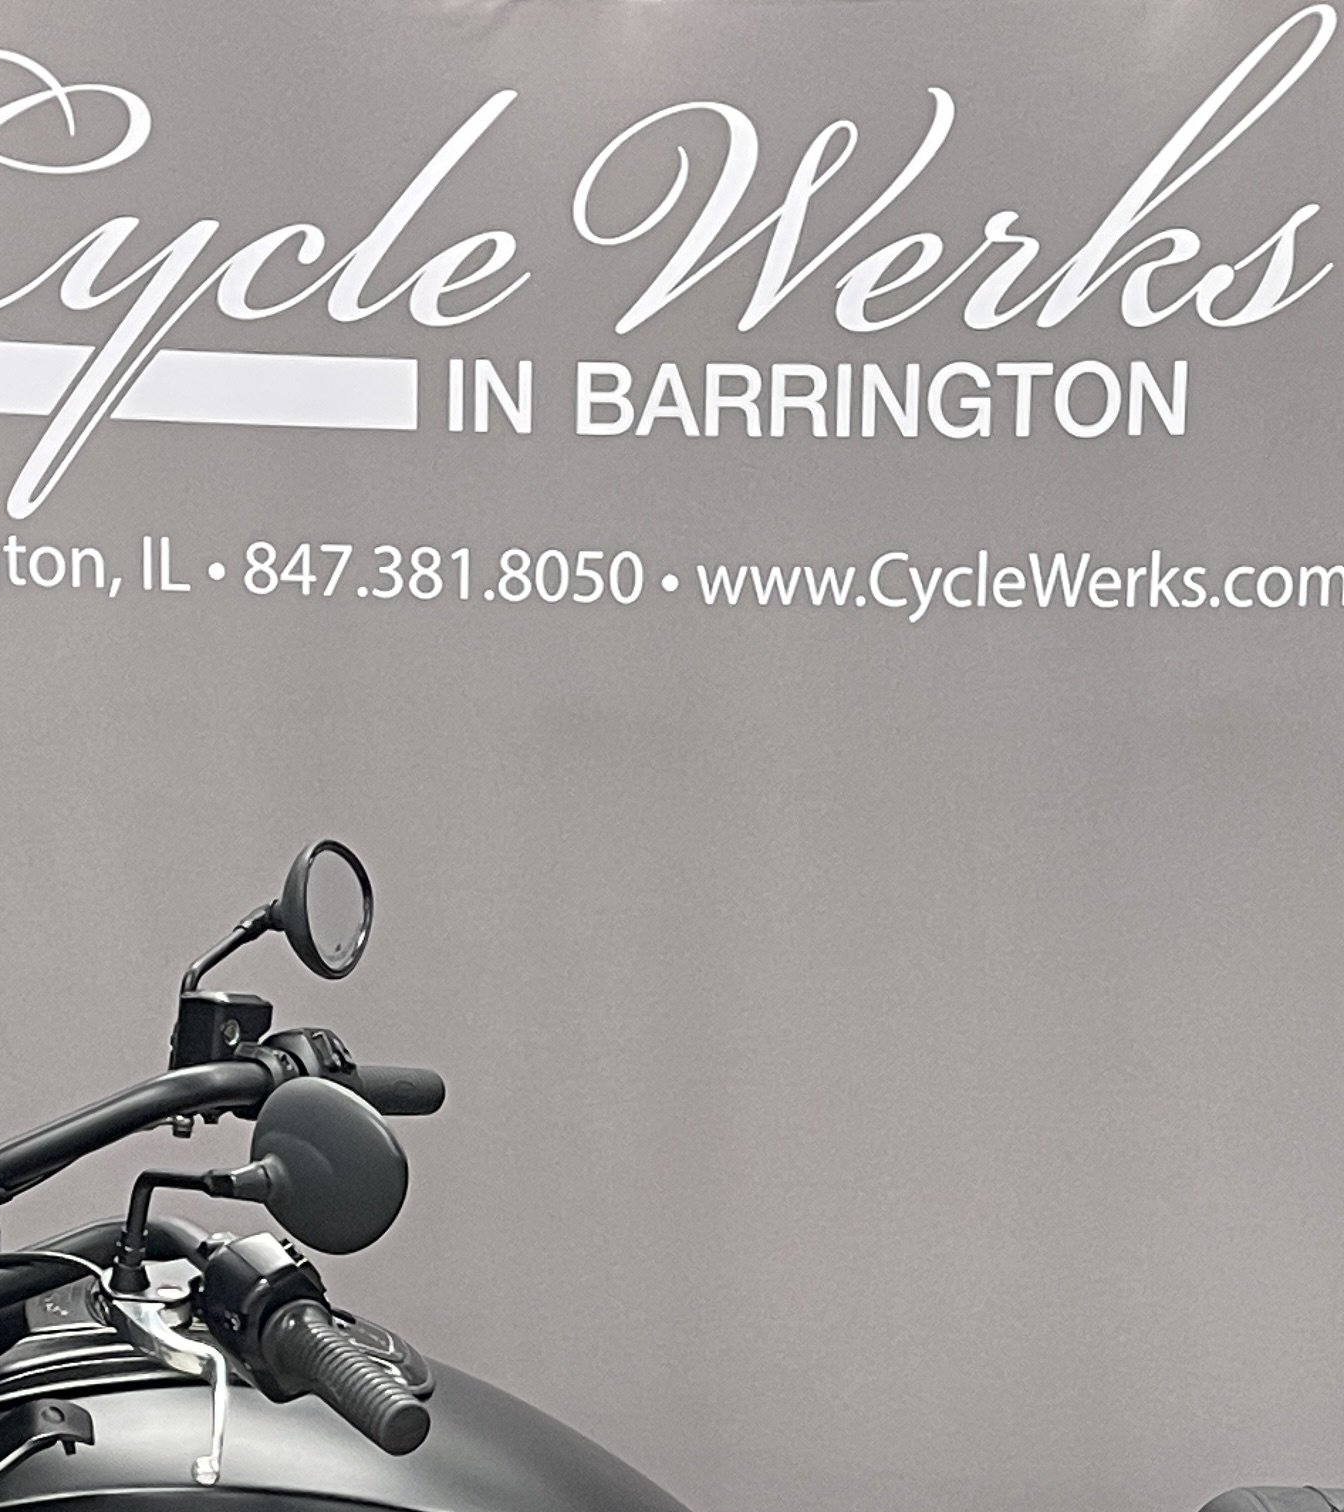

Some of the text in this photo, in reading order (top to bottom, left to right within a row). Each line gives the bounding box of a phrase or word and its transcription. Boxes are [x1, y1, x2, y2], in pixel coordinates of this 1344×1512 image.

[572, 3, 1338, 335] Werks
[448, 358, 1189, 439] IN BARRINGTON
[142, 535, 191, 592] IL
[243, 541, 645, 604] 847.381.8050
